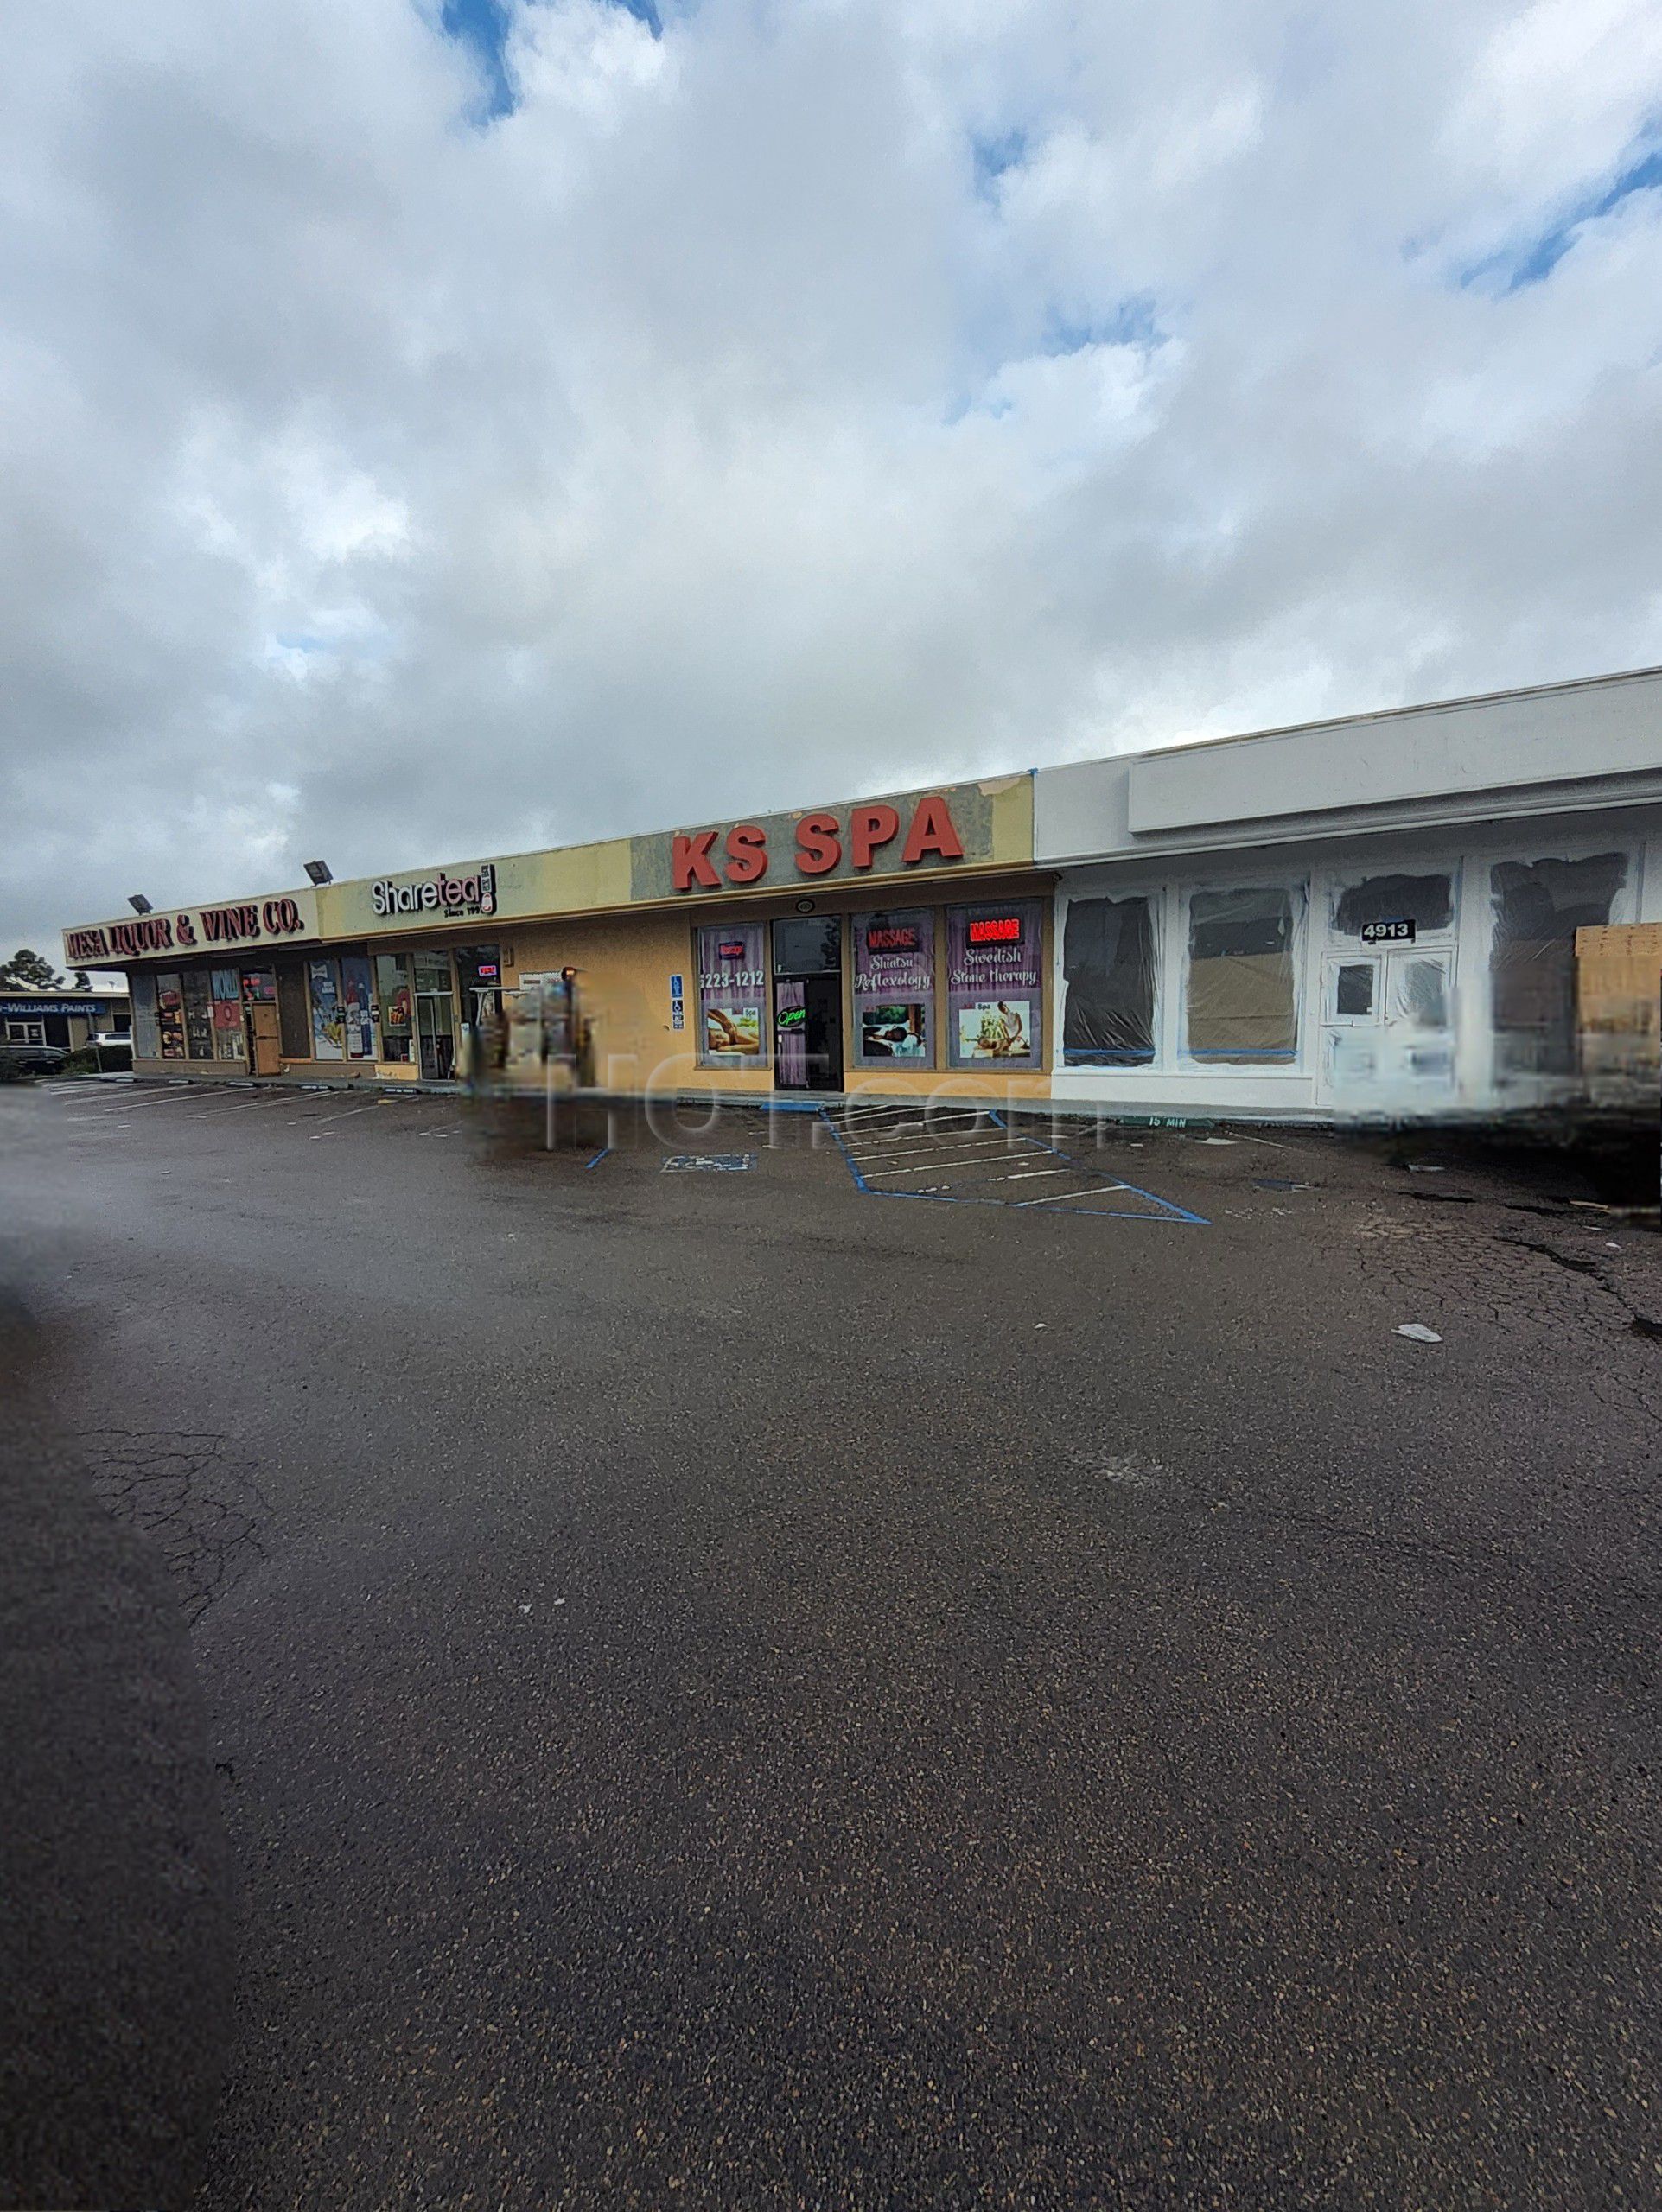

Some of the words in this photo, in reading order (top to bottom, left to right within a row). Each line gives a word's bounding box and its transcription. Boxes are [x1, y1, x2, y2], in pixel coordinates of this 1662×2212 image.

[672, 825, 767, 890] KS
[794, 796, 964, 874] SPA
[66, 930, 109, 959] MESA
[107, 918, 174, 957] LIQUOR
[176, 914, 198, 946] &
[200, 905, 260, 942] WINE
[263, 899, 305, 933] CO.
[869, 927, 916, 948] MASSAGE
[970, 918, 1020, 942] MASSAGE
[1364, 923, 1409, 938] 4913
[964, 949, 1022, 967] Swedish
[854, 973, 931, 992] Reflexology
[951, 969, 986, 985] Stone
[989, 968, 1037, 987] therapy
[779, 1008, 806, 1025] Open
[1149, 1116, 1161, 1127] 15
[1166, 1118, 1187, 1128] MIN
